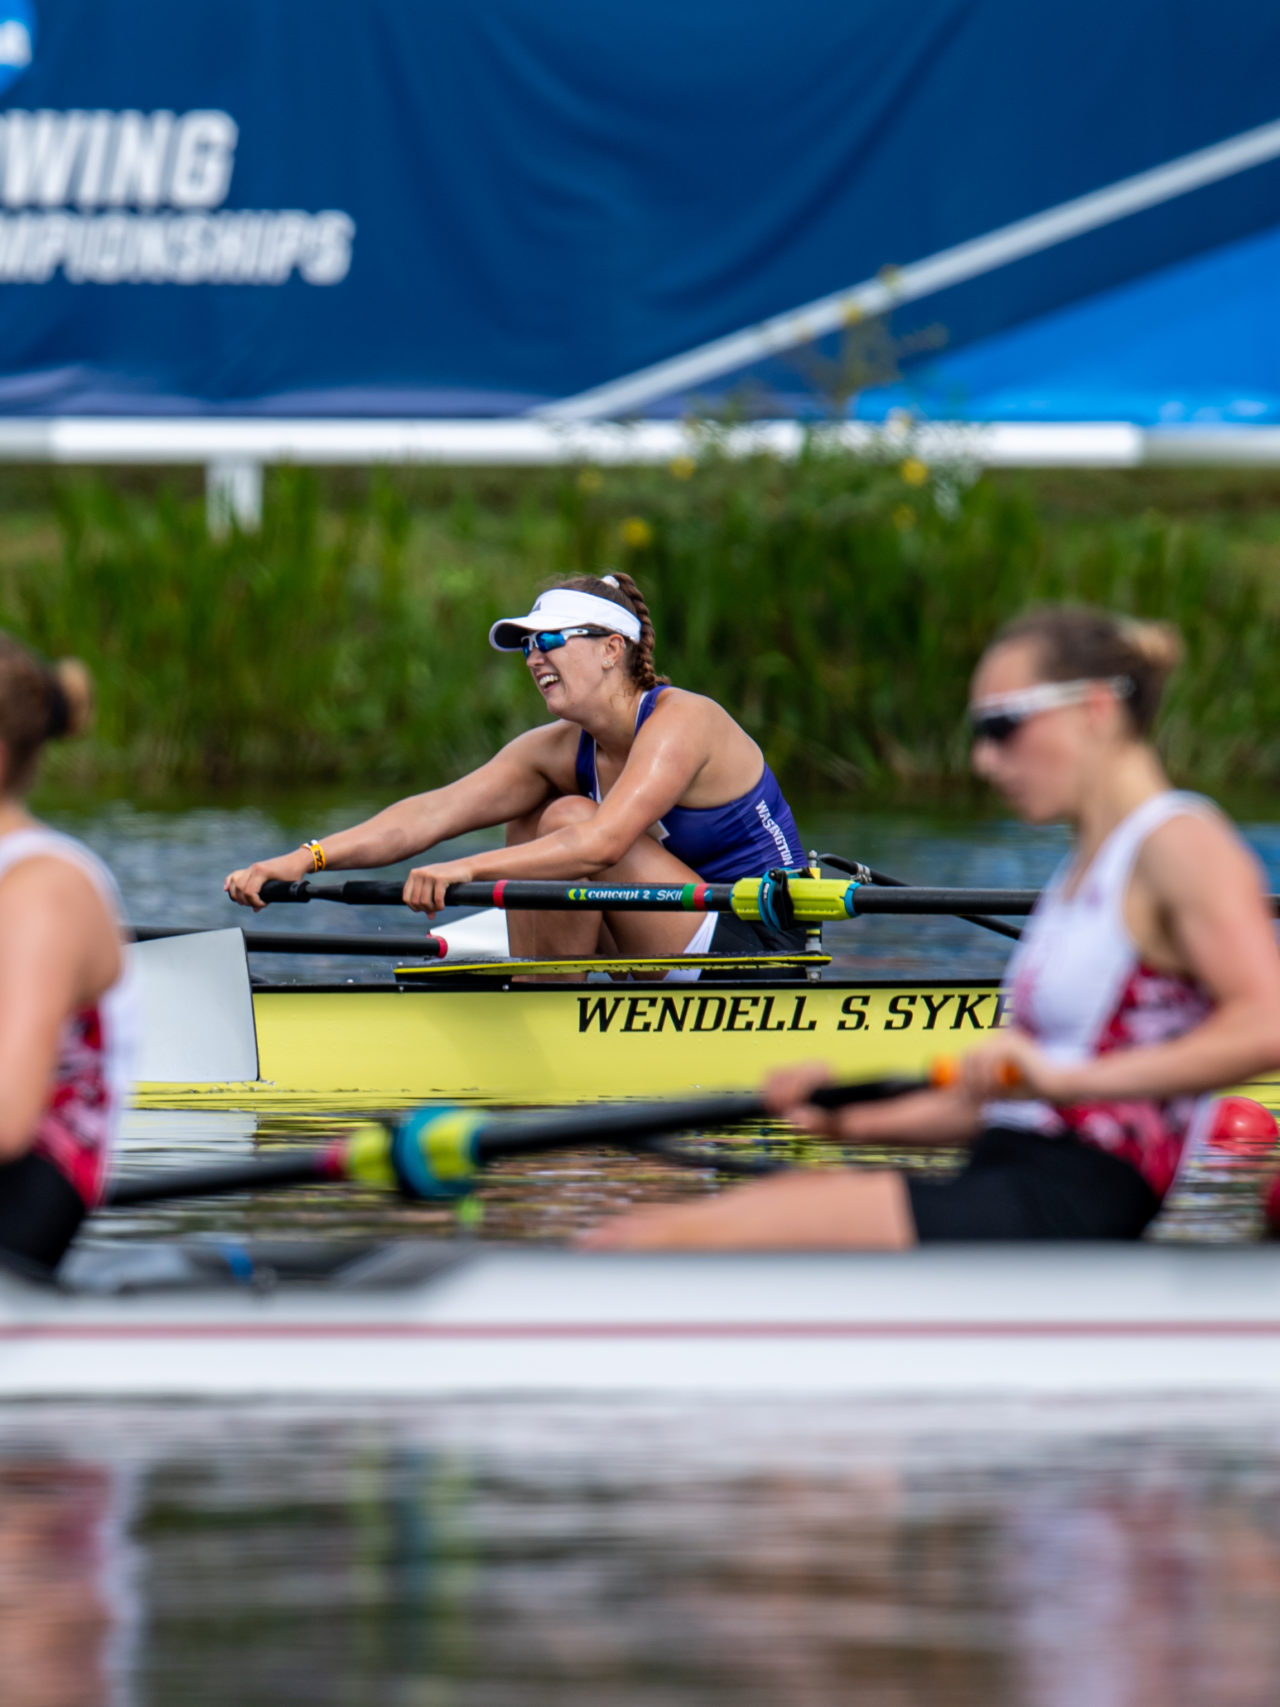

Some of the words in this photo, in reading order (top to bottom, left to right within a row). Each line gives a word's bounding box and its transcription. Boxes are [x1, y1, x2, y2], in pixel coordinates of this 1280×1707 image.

[755, 799, 794, 867] WASINGTON
[587, 889, 639, 900] concept
[642, 890, 651, 900] 2
[577, 995, 817, 1033] WENDELL
[837, 995, 871, 1031] S.
